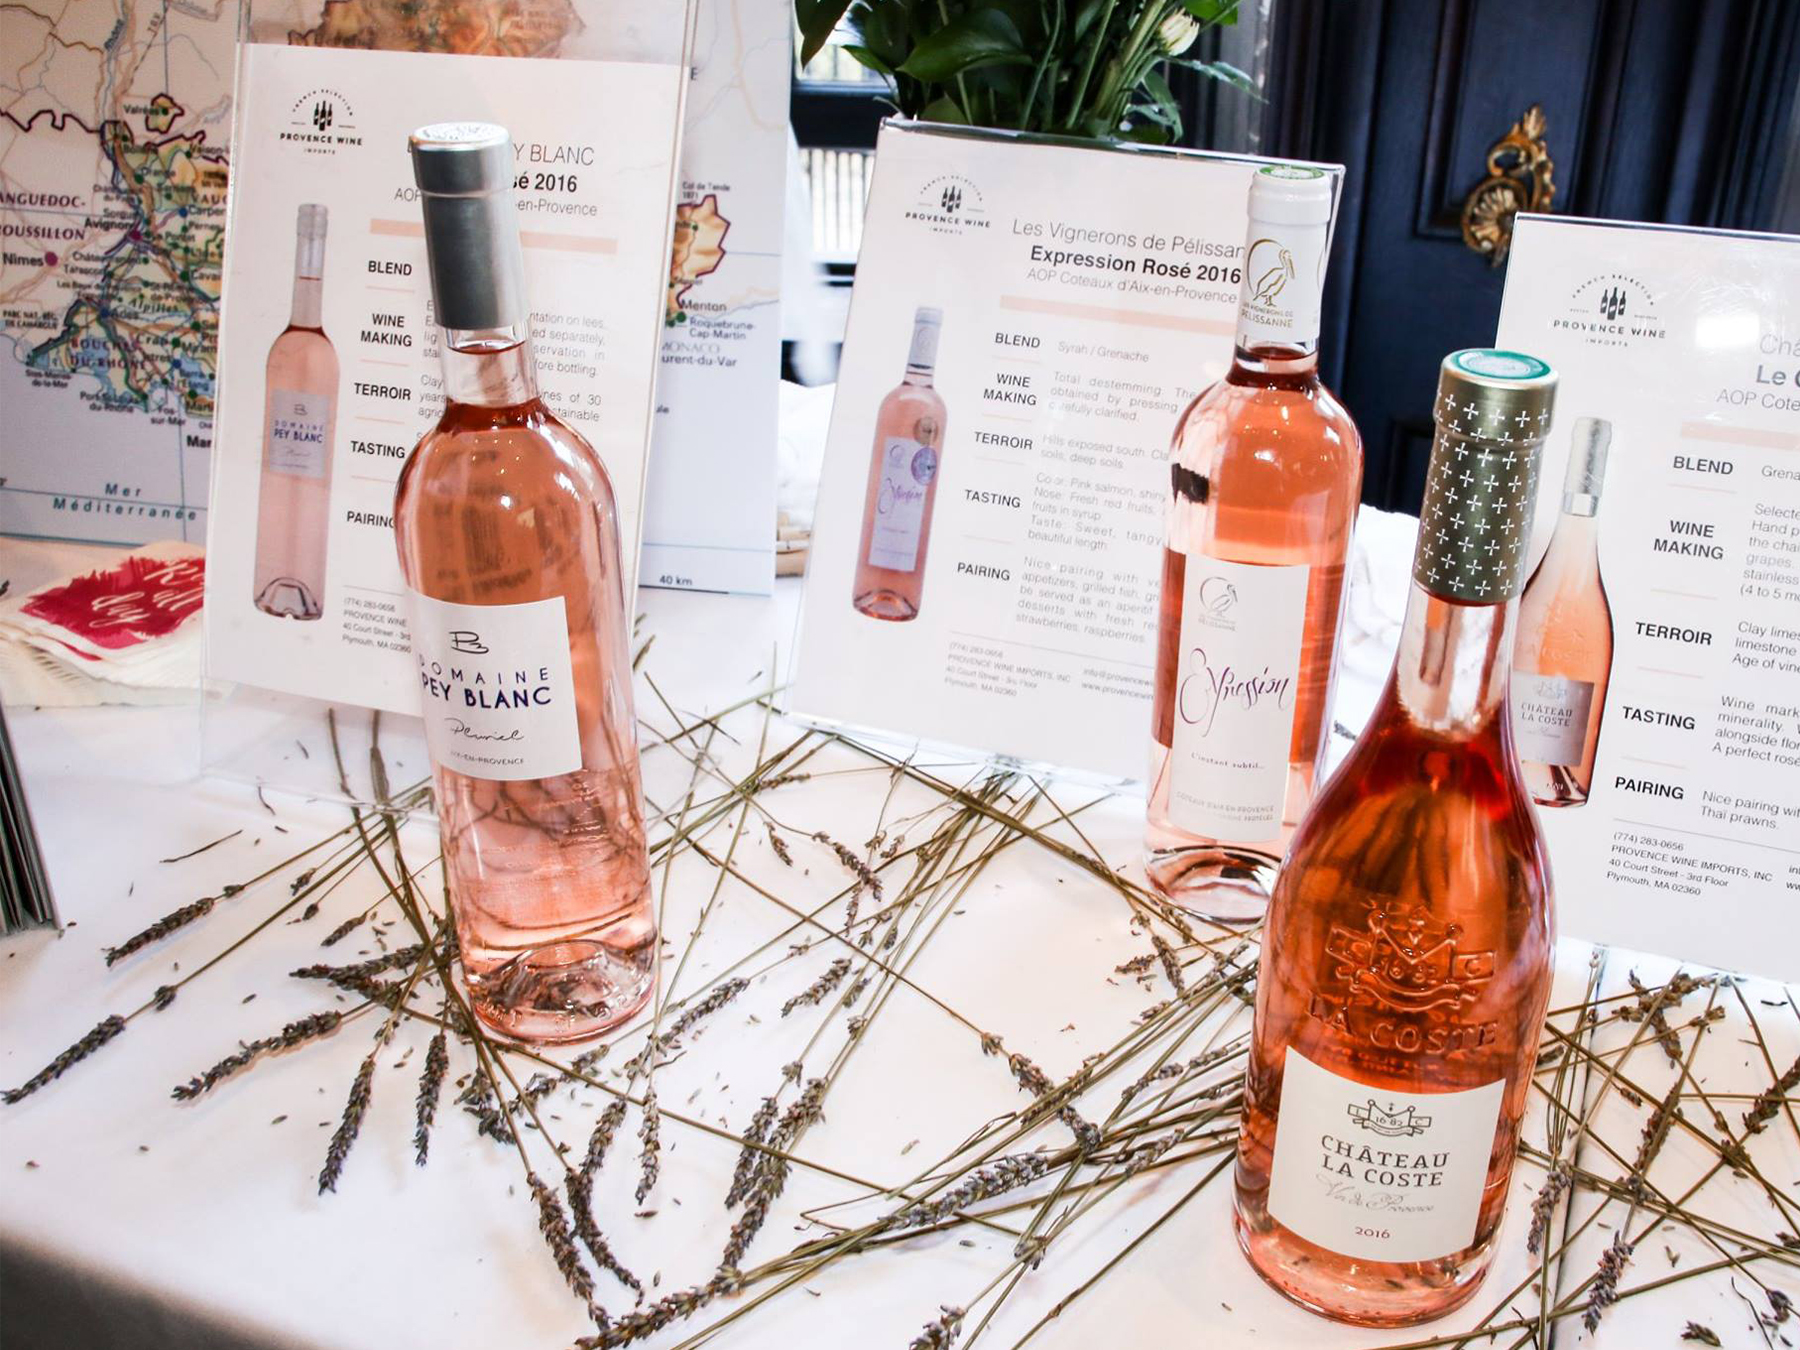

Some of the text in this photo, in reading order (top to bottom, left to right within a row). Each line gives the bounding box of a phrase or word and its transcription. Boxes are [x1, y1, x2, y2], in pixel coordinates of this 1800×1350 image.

[280, 132, 363, 146] PROVENCE WINE
[530, 143, 595, 166] BLANC
[534, 173, 578, 193] 2016
[0, 192, 86, 208] ANGUEDOC-
[394, 188, 423, 202] AOP
[84, 218, 134, 231] Avignon
[905, 211, 991, 228] PROVENCE WINE
[0, 225, 85, 241] OUSSILLON
[1012, 218, 1245, 259] Les Vignerons de Pélissan
[368, 260, 412, 276] BLEND
[1031, 245, 1242, 284] Expression Rosé 2016
[1026, 267, 1057, 282] AOP
[1059, 271, 1113, 290] Coteaux
[682, 300, 727, 313] Menton
[372, 313, 405, 328] WINE
[1553, 319, 1666, 339] PROVENCE WINE
[361, 330, 412, 347] MAKING
[994, 332, 1150, 363] BLEND Syrah Grenache
[533, 344, 586, 358] servation
[662, 355, 738, 368] urent-du-Var
[996, 373, 1031, 388] WINE
[1054, 371, 1081, 385] Total
[1756, 364, 1786, 386] Le
[354, 383, 412, 400] TERROIR
[983, 388, 1037, 406] MAKING
[1051, 387, 1179, 413] obtained by pressing
[1716, 388, 1800, 412] AOP Cote
[1049, 402, 1093, 417] crefully
[274, 428, 324, 443] PEY BLANC
[974, 431, 1033, 450] TERROIR
[351, 440, 405, 458] TASTING
[1673, 456, 1800, 481] BLEND Grena
[105, 483, 142, 497] Mer
[964, 489, 1021, 508] TASTING
[53, 497, 197, 520] Méditerranée
[1754, 503, 1800, 520] Selecte
[1670, 520, 1715, 539] WINE
[1751, 520, 1788, 535] Hand
[1653, 538, 1724, 560] MAKING
[1749, 536, 1770, 549] the
[659, 575, 692, 586] 40 km
[957, 562, 1011, 581] PAIRING
[1743, 569, 1799, 586] stainless
[1756, 586, 1770, 598] to
[1773, 588, 1782, 600] 5
[1635, 621, 1712, 646] TERROIR
[1738, 621, 1800, 640] Clay limes
[1735, 637, 1797, 657] limestone
[1731, 653, 1800, 674] Age of vine
[421, 672, 552, 710] PEY BLANC
[1721, 695, 1800, 719] Wine mark
[1538, 715, 1571, 727] COSTE
[1622, 706, 1696, 730] TASTING
[1715, 728, 1778, 747] alongside
[1711, 742, 1722, 753] A
[1725, 745, 1771, 762] perfect
[1614, 776, 1684, 800] PAIRING
[1703, 790, 1780, 818] Nice pairing
[1613, 832, 1638, 845] (774)
[1611, 844, 1668, 863] PROVENCE
[1671, 855, 1698, 868] WINE
[1754, 871, 1773, 882] INC
[1609, 858, 1729, 888] 40 Court Street 3rd Floor
[1654, 879, 1670, 891] MA
[1672, 882, 1702, 896] 02360
[1369, 1021, 1499, 1056] COSTE
[1321, 1135, 1450, 1169] CHÂTEAU
[1321, 1153, 1443, 1188] LA COSTE
[1354, 1226, 1391, 1239] 2016
